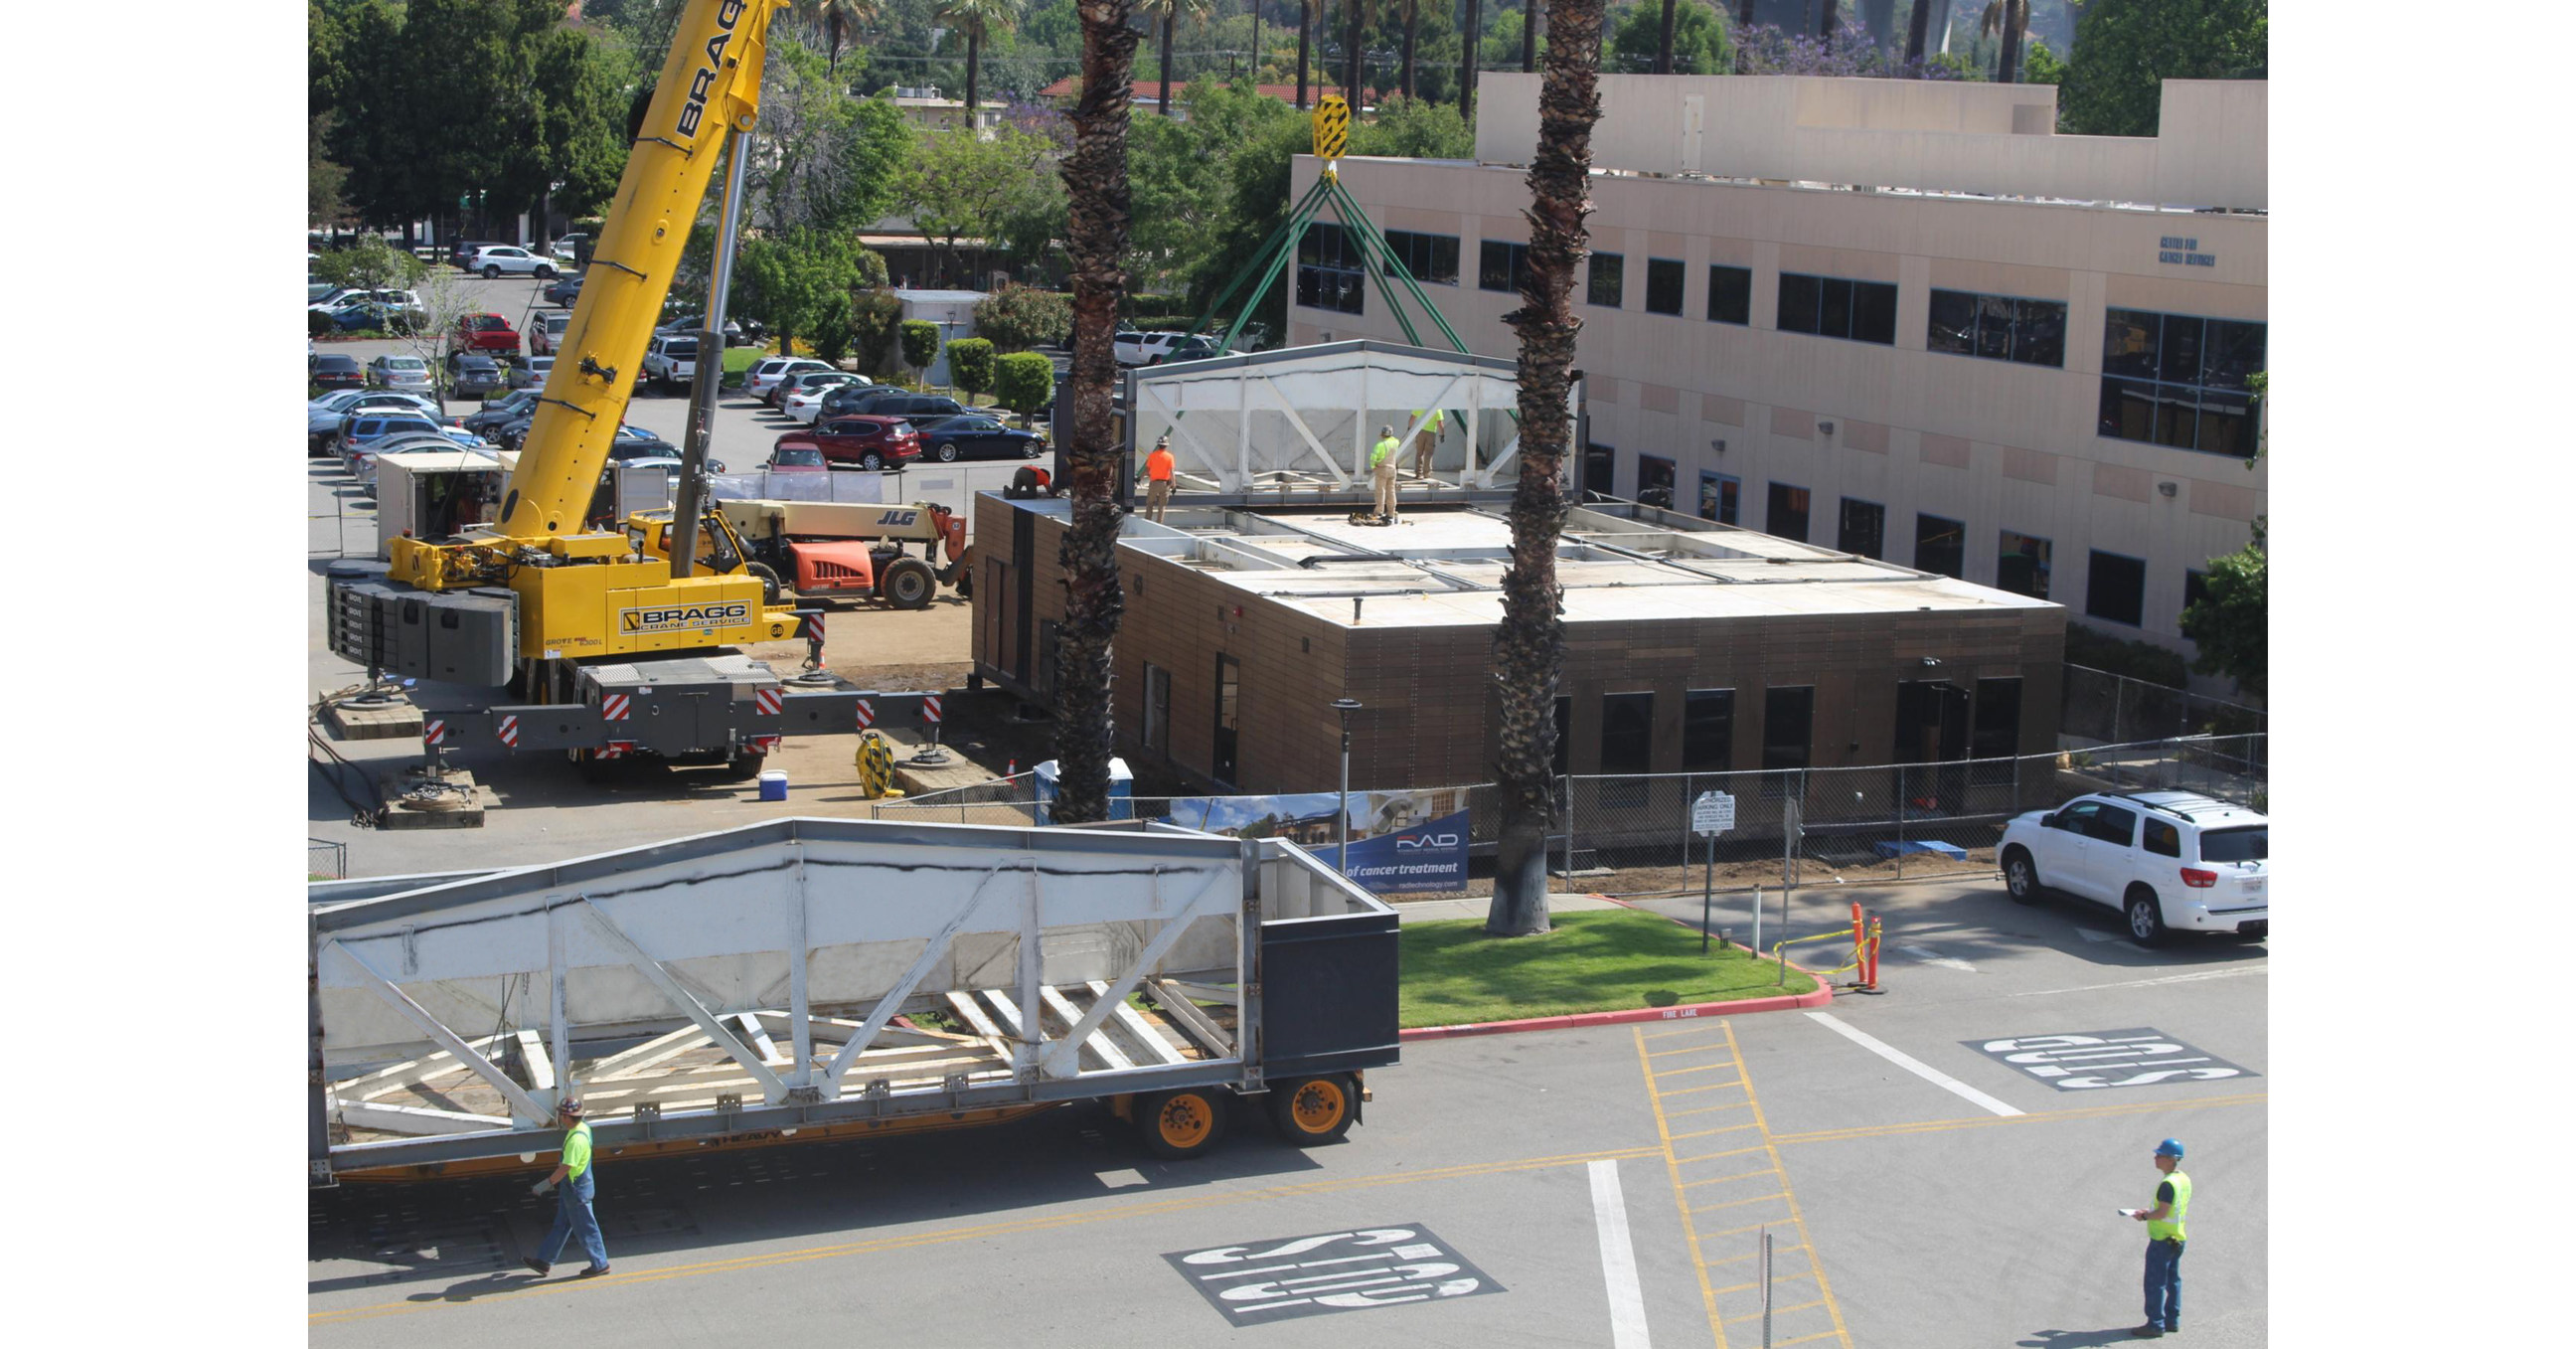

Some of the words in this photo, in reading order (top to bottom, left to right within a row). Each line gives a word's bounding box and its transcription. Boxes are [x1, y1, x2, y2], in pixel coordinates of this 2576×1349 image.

[877, 510, 918, 527] JLG
[643, 604, 746, 624] BRAGG
[640, 620, 688, 631] CRANE
[692, 616, 750, 626] SERVICE
[771, 626, 783, 635] GB
[545, 637, 572, 646] GROVE
[1397, 834, 1458, 848] RAD
[1346, 865, 1361, 877] of
[1360, 866, 1398, 876] cancer
[1399, 863, 1458, 874] treatment
[1983, 1035, 2240, 1089] STOP
[723, 1130, 781, 1142] HEAVY
[1182, 1229, 1480, 1313] STOP
